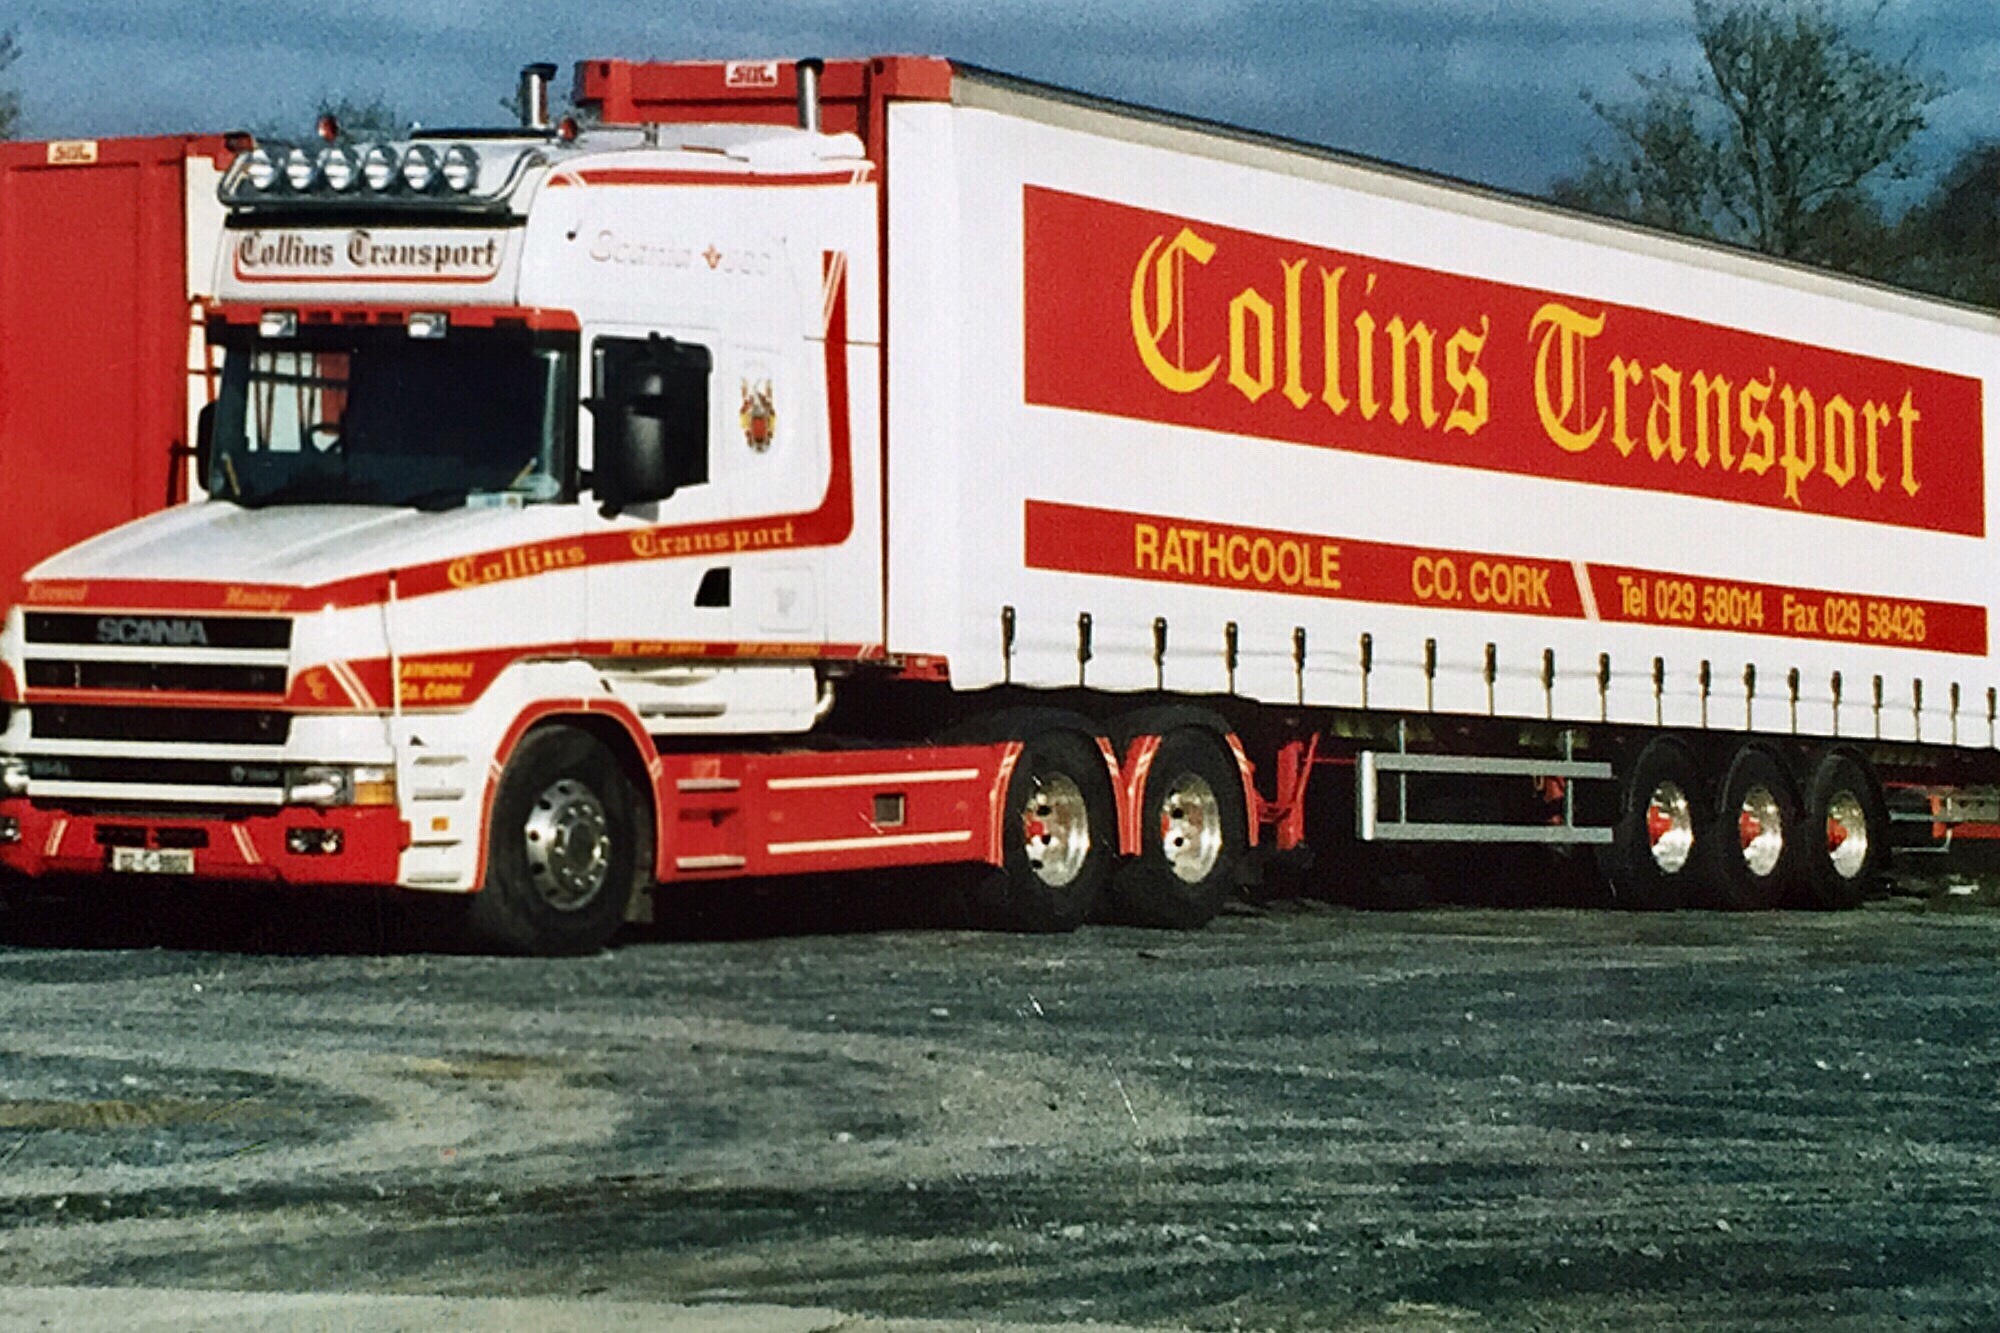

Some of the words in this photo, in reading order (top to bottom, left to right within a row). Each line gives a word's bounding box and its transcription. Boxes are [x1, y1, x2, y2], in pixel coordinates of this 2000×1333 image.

[239, 231, 333, 267] Collins
[347, 230, 497, 272] Transport
[1130, 227, 1489, 436] Collins
[1528, 302, 1920, 506] Transport
[447, 544, 586, 590] Collins
[630, 521, 796, 559] Transport
[1134, 523, 1342, 590] RATHCOOLE
[1411, 555, 1462, 600] CO.
[1469, 560, 1551, 608] CORK
[1618, 576, 1647, 617] Tel
[1654, 580, 1695, 622] 029
[1702, 585, 1765, 628] 58014
[1782, 594, 1818, 633] Fax
[1824, 598, 1860, 637] 029
[1867, 602, 1926, 642] 58426
[97, 617, 208, 645] SCANIA
